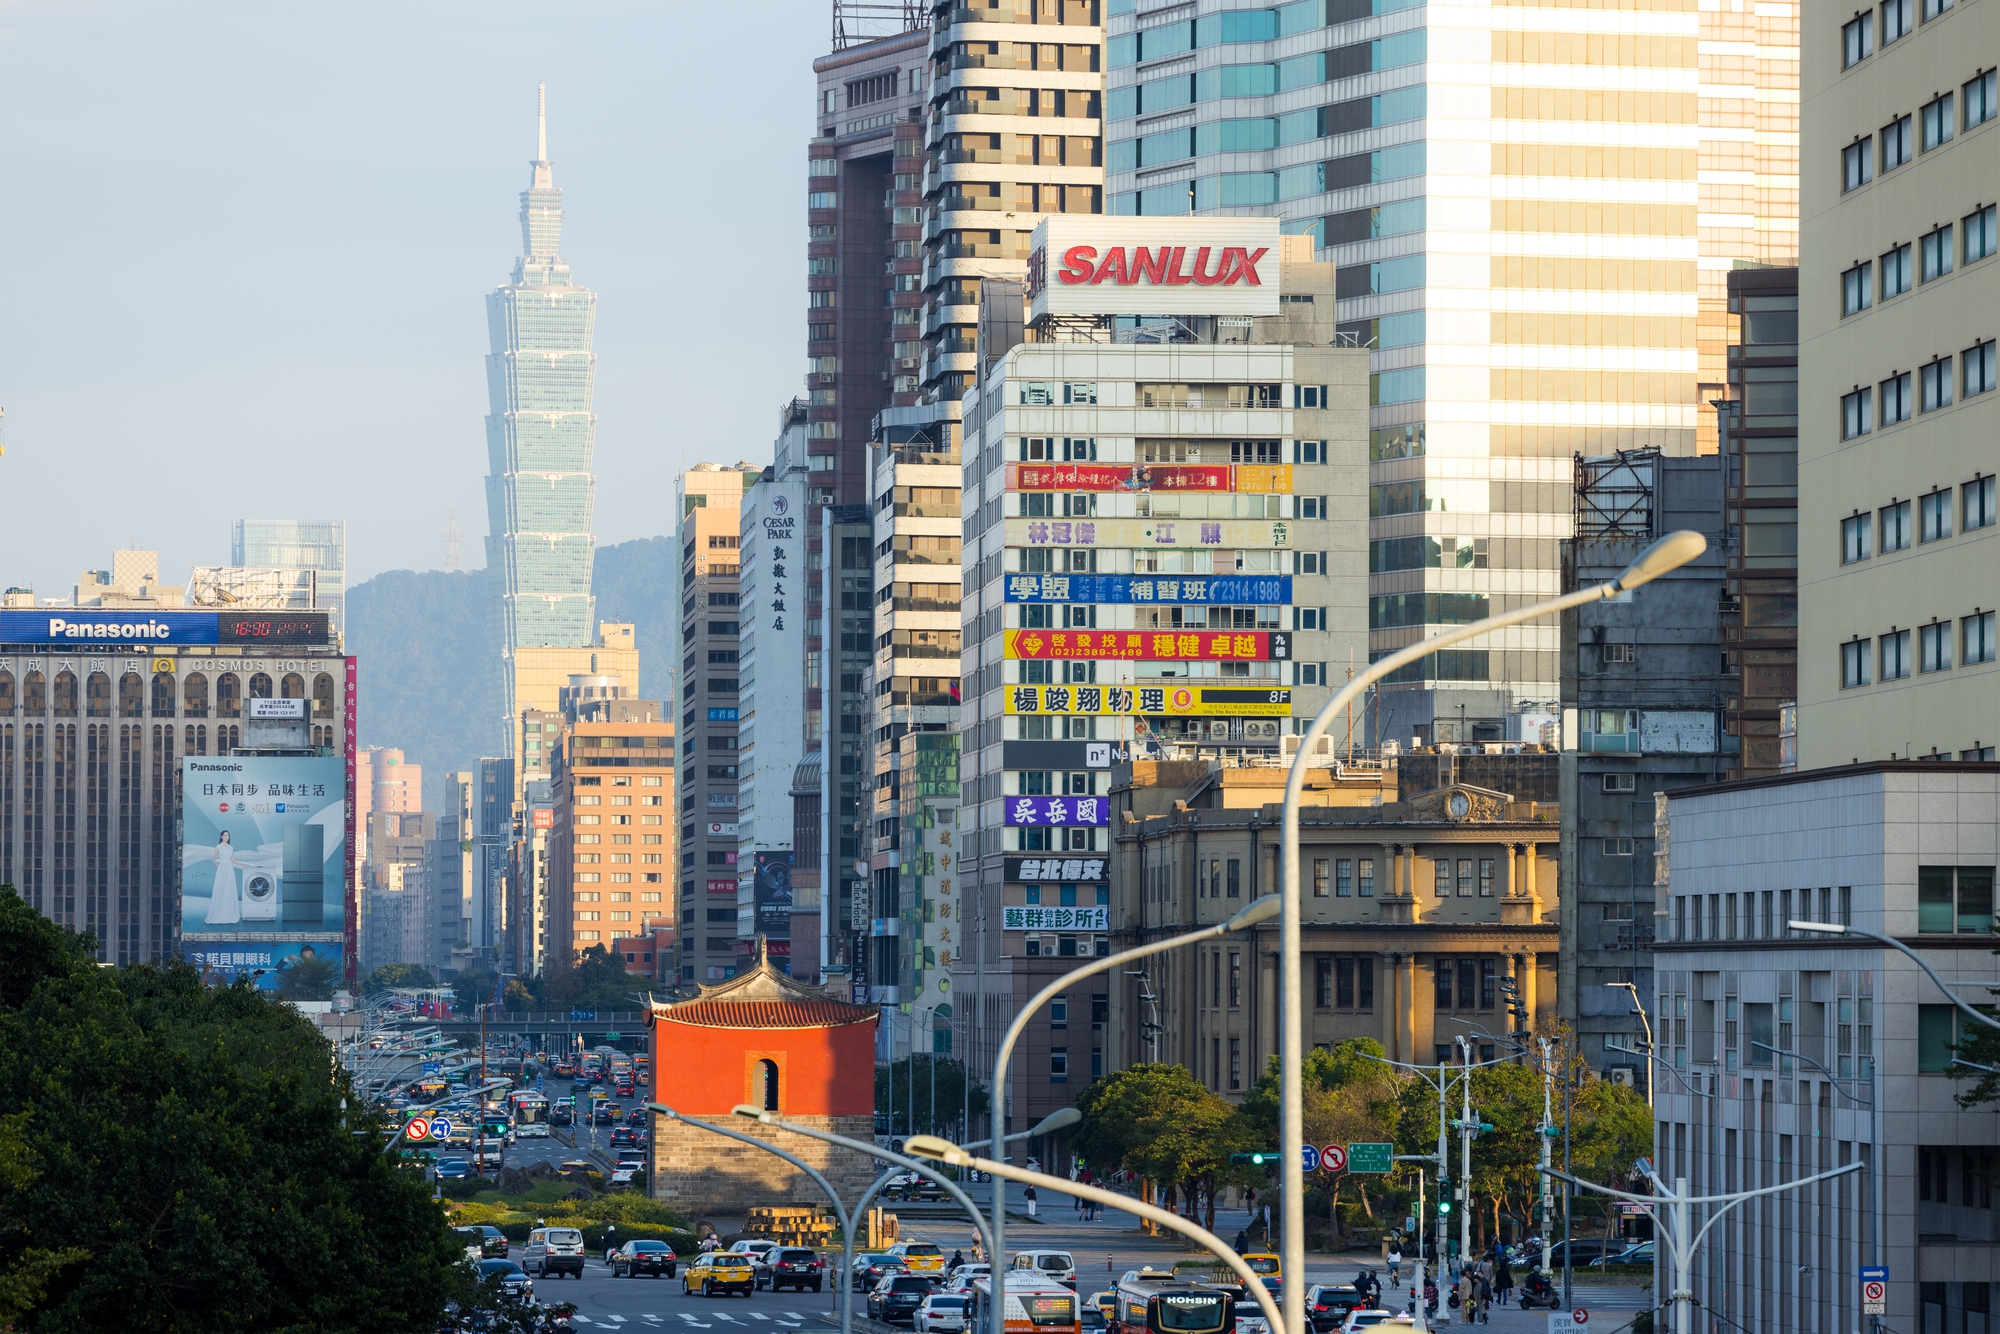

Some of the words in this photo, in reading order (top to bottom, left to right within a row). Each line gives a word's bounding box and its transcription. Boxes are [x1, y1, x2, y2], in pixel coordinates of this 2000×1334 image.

[1058, 245, 1270, 285] SANLUX
[1163, 473, 1218, 487] 本棟12樓
[767, 530, 792, 539] PARK
[1028, 522, 1095, 544] 林冠傑
[772, 546, 787, 631] 凱撒大飯店
[1010, 577, 1070, 600] 學盟
[1129, 581, 1206, 600] 補習班
[1221, 581, 1280, 600] 2314-1988
[49, 619, 169, 638] Panasonic
[235, 621, 270, 636] 16:30
[1153, 634, 1200, 657] 穩健
[1210, 635, 1257, 657] 卓越
[1275, 635, 1286, 657] 九樓
[192, 660, 267, 671] COSMOS
[275, 660, 329, 672] HOTEL
[1013, 687, 1165, 712] 楊竣翔物理
[1269, 690, 1288, 702] 8F
[190, 763, 243, 772] Panasonic
[203, 783, 259, 796] 日本同步
[268, 783, 325, 796] 品味生活
[1014, 798, 1110, 823] 吳岳國
[1019, 860, 1110, 880] 台北偉文
[853, 882, 861, 901] Click
[939, 831, 952, 967] 城中消防大樓
[853, 903, 861, 925] Hotel
[206, 952, 271, 966] 諾貝爾眼科
